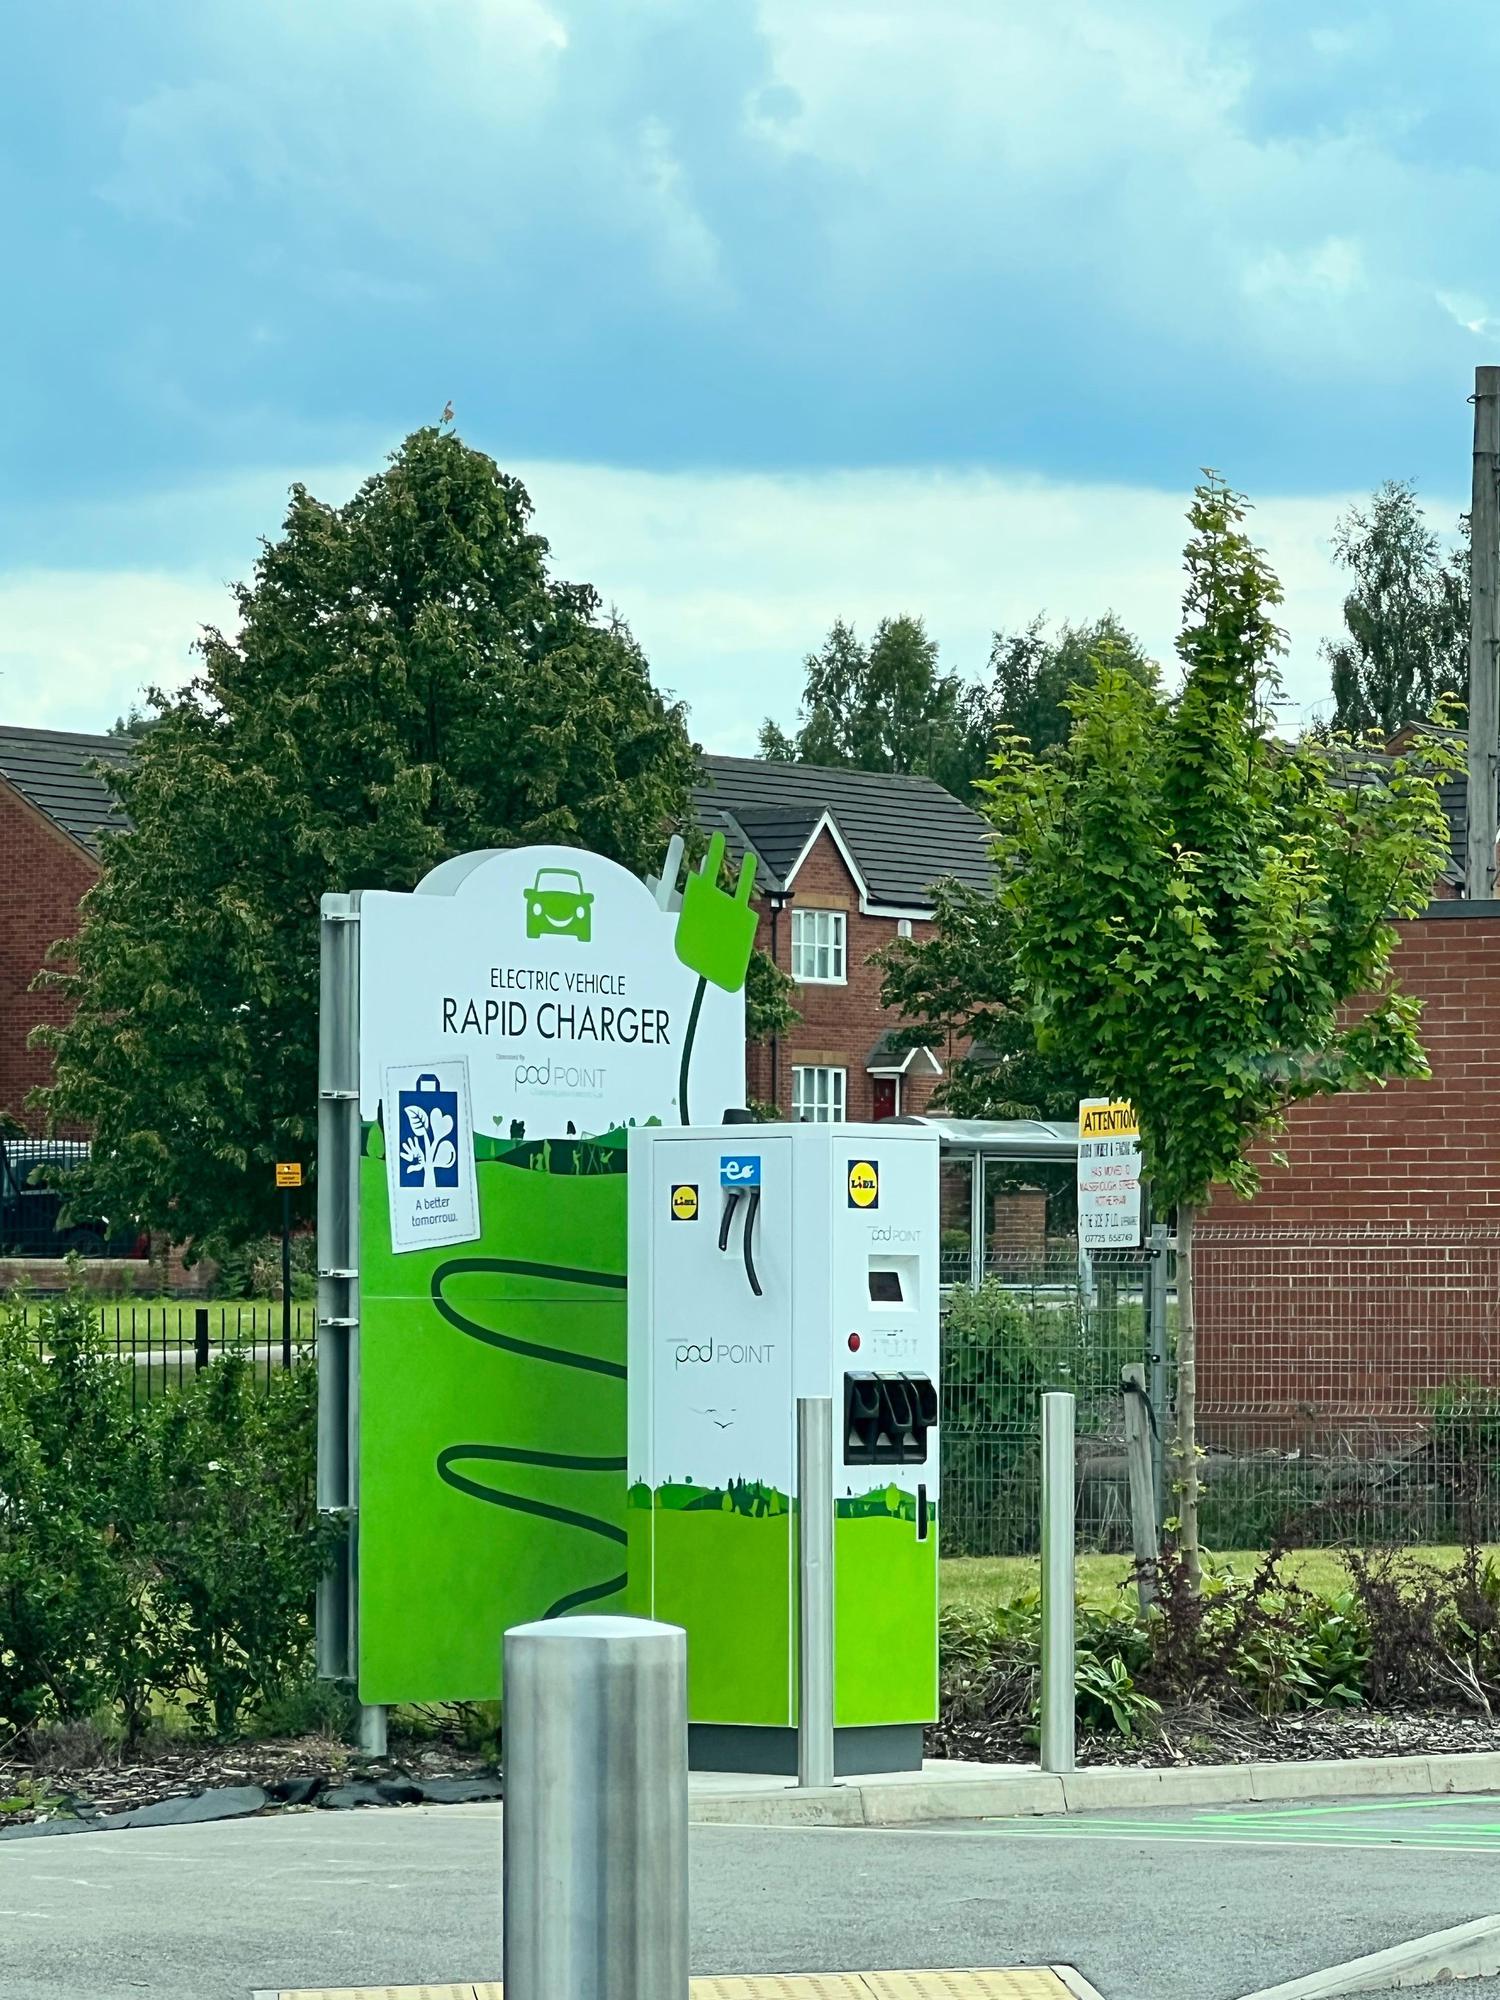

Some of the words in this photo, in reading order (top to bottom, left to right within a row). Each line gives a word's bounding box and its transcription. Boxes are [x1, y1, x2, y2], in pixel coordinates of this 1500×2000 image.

[490, 967, 560, 992] ELECTRIC
[564, 972, 626, 995] VEHICLE
[443, 997, 527, 1037] RAPID
[537, 1003, 671, 1044] CHARGER
[514, 1057, 550, 1092] pod
[554, 1067, 607, 1088] POINT
[1084, 1109, 1137, 1131] ATTENTION
[415, 1199, 422, 1210] A
[424, 1197, 450, 1209] better
[411, 1212, 458, 1227] tomorrow.
[893, 1230, 920, 1241] POINT
[675, 1336, 712, 1371] pod
[717, 1344, 775, 1363] POINT
